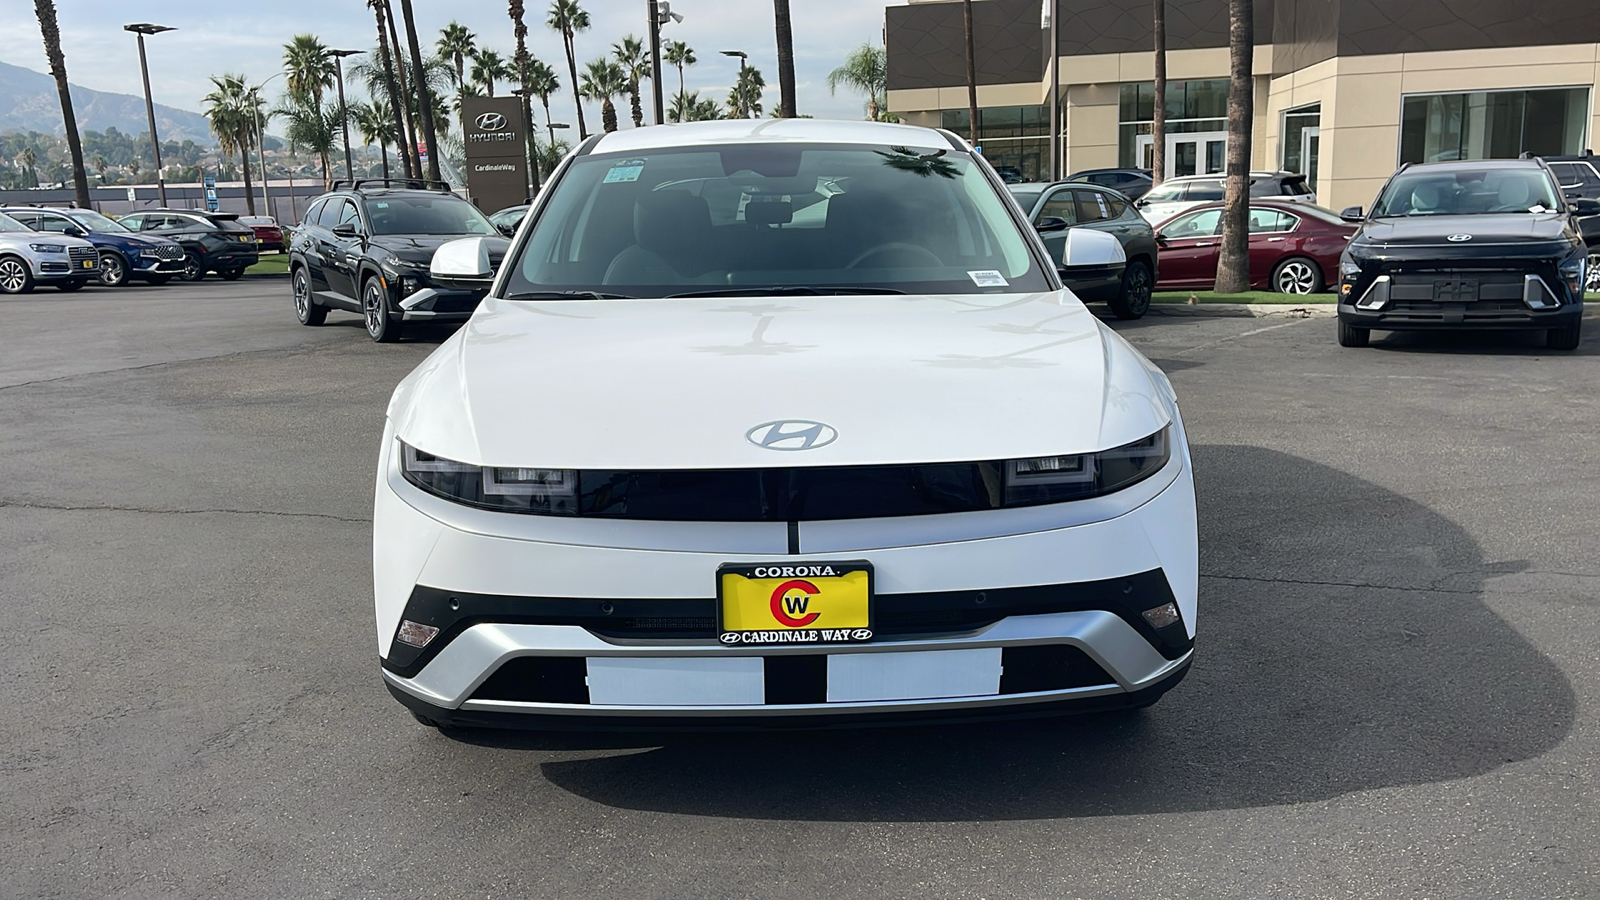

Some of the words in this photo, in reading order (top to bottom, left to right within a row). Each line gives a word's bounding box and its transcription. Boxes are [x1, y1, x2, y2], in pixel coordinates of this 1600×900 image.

[469, 132, 516, 143] HYUNDAI
[474, 163, 516, 172] CardinaleWay
[754, 566, 836, 578] CORONA
[784, 595, 811, 614] W
[741, 630, 819, 643] CARDINALE
[820, 629, 852, 641] WAY
